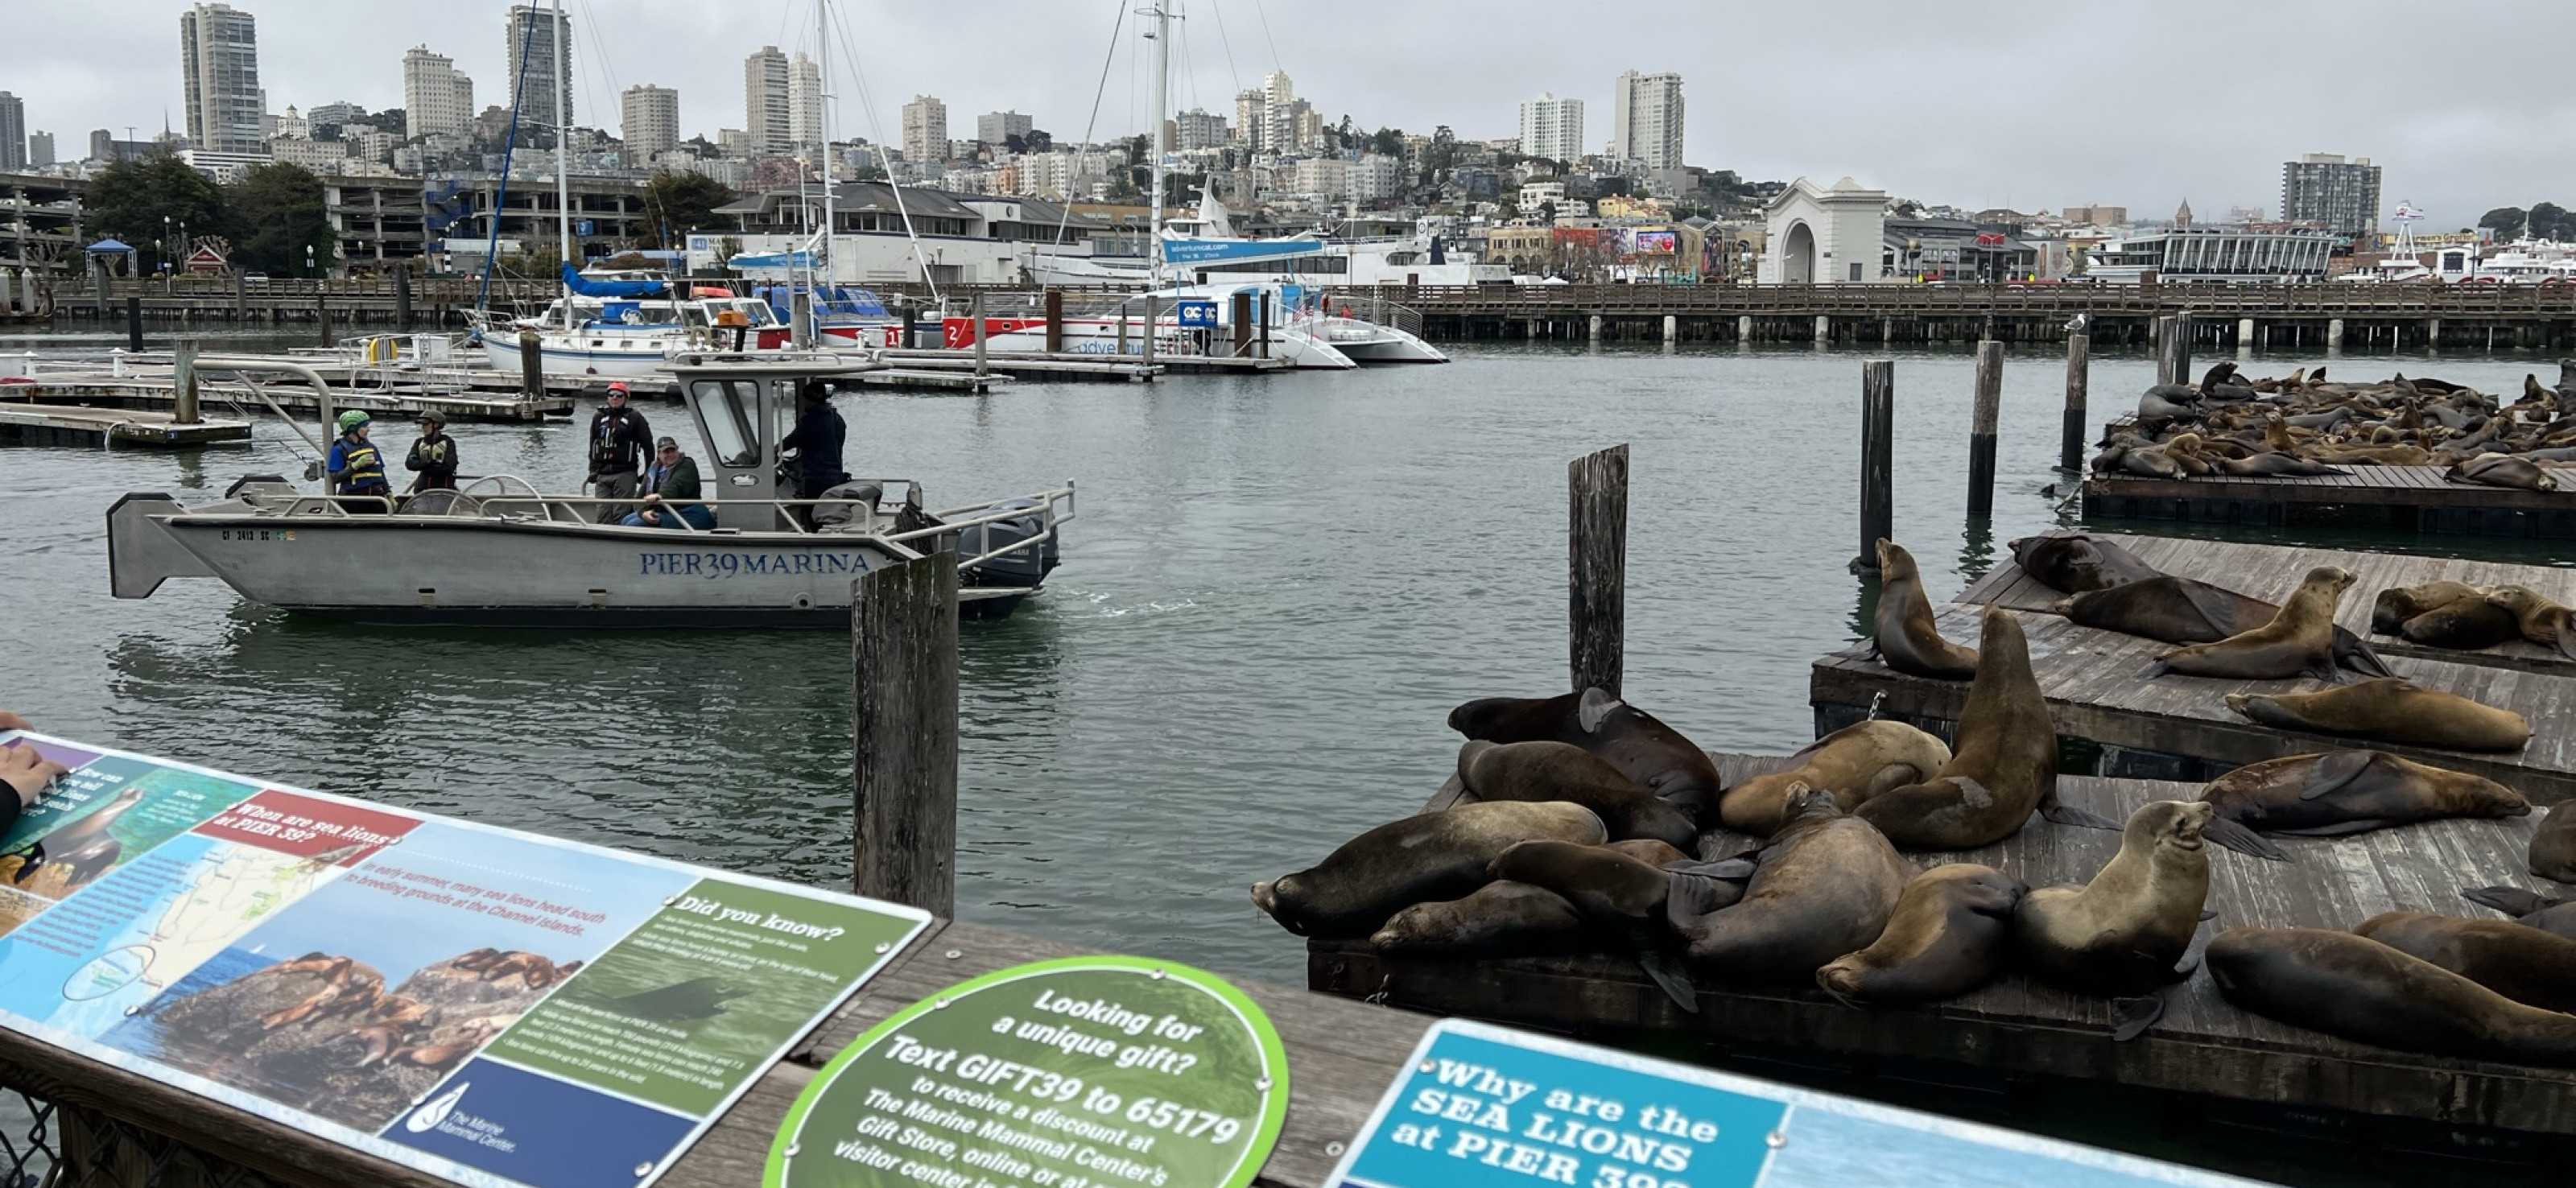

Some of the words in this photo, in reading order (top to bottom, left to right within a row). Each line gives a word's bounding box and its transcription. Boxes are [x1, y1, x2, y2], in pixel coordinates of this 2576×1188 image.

[888, 332, 897, 344] 1
[949, 326, 957, 340] 2
[741, 553, 869, 574] MARINA
[213, 815, 233, 827] at
[232, 818, 279, 836] PIER
[278, 827, 316, 843] 39?
[237, 803, 283, 823] When
[282, 814, 312, 828] are
[311, 821, 343, 836] sea
[673, 895, 721, 915] Did
[714, 906, 762, 925] you
[761, 913, 845, 941] know?
[1033, 988, 1153, 1035] Looking
[1153, 1014, 1204, 1042] for
[992, 1016, 1016, 1033] a
[1015, 1020, 1117, 1058] unique
[1115, 1044, 1198, 1076] gift?
[885, 1033, 958, 1072] Text
[956, 1054, 1084, 1102] GIFT39
[1082, 1085, 1119, 1114] to
[1124, 1095, 1241, 1145] 65179
[911, 1075, 936, 1094] to
[935, 1083, 1013, 1115] receive
[1011, 1104, 1030, 1120] a
[1030, 1108, 1129, 1146] discount
[1126, 1132, 1155, 1153] at
[1435, 1058, 1537, 1105] Why
[1545, 1088, 1624, 1122] are
[1640, 1103, 1719, 1143] the
[436, 1120, 484, 1141] Mammal
[449, 1110, 470, 1125] The
[468, 1116, 505, 1136] Marine
[863, 1087, 903, 1114] The
[902, 1099, 978, 1134] Marine
[976, 1119, 1077, 1160] Mammal
[1075, 1146, 1168, 1186] Center's
[1410, 1087, 1512, 1133] SEA
[1521, 1111, 1694, 1172] LIONS
[834, 1140, 902, 1171] visitor
[857, 1116, 899, 1141] Gift
[897, 1127, 958, 1161] Store,
[963, 1144, 1032, 1178] online
[1031, 1167, 1062, 1187] or
[1391, 1121, 1442, 1152] at
[1447, 1129, 1583, 1186] PIER
[1591, 1163, 1690, 1188] 39
